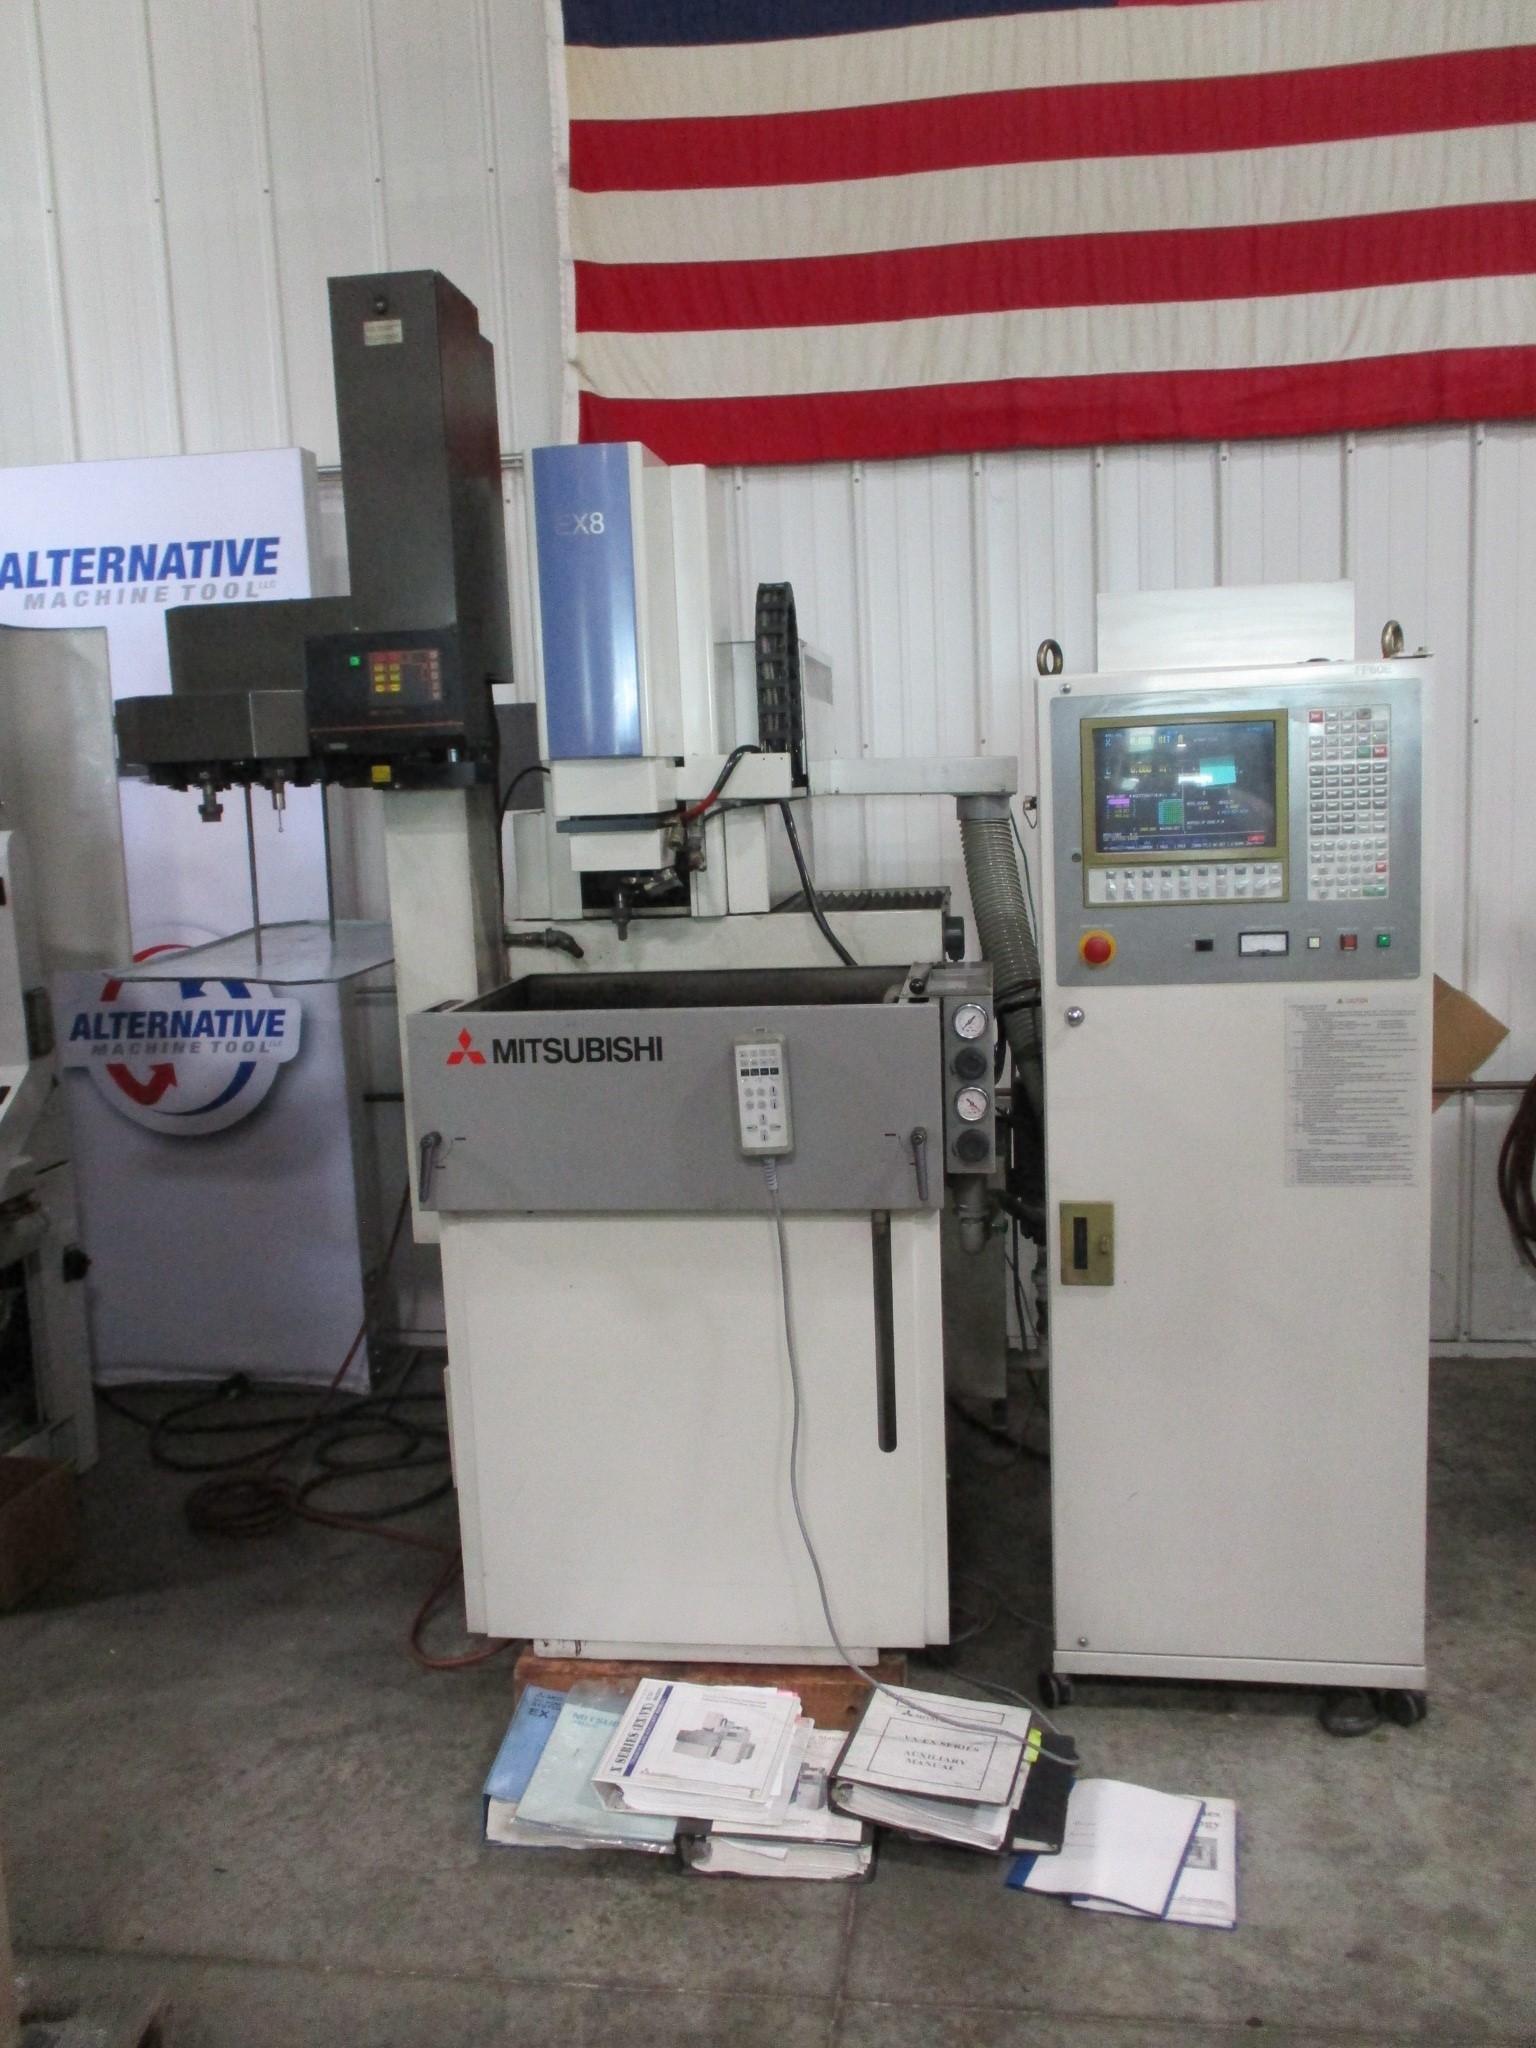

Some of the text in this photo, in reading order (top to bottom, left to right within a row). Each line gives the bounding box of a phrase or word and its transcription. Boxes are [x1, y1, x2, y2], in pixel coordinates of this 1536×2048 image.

[0, 536, 280, 591] ALTERNATIVE
[23, 585, 172, 611] MACHINE
[181, 581, 260, 602] TOOL
[69, 1009, 286, 1041] ALTERNATIVE
[91, 1040, 201, 1056] MACHINE
[208, 1039, 271, 1055] TOOL
[492, 1036, 664, 1064] MITSUBISHI
